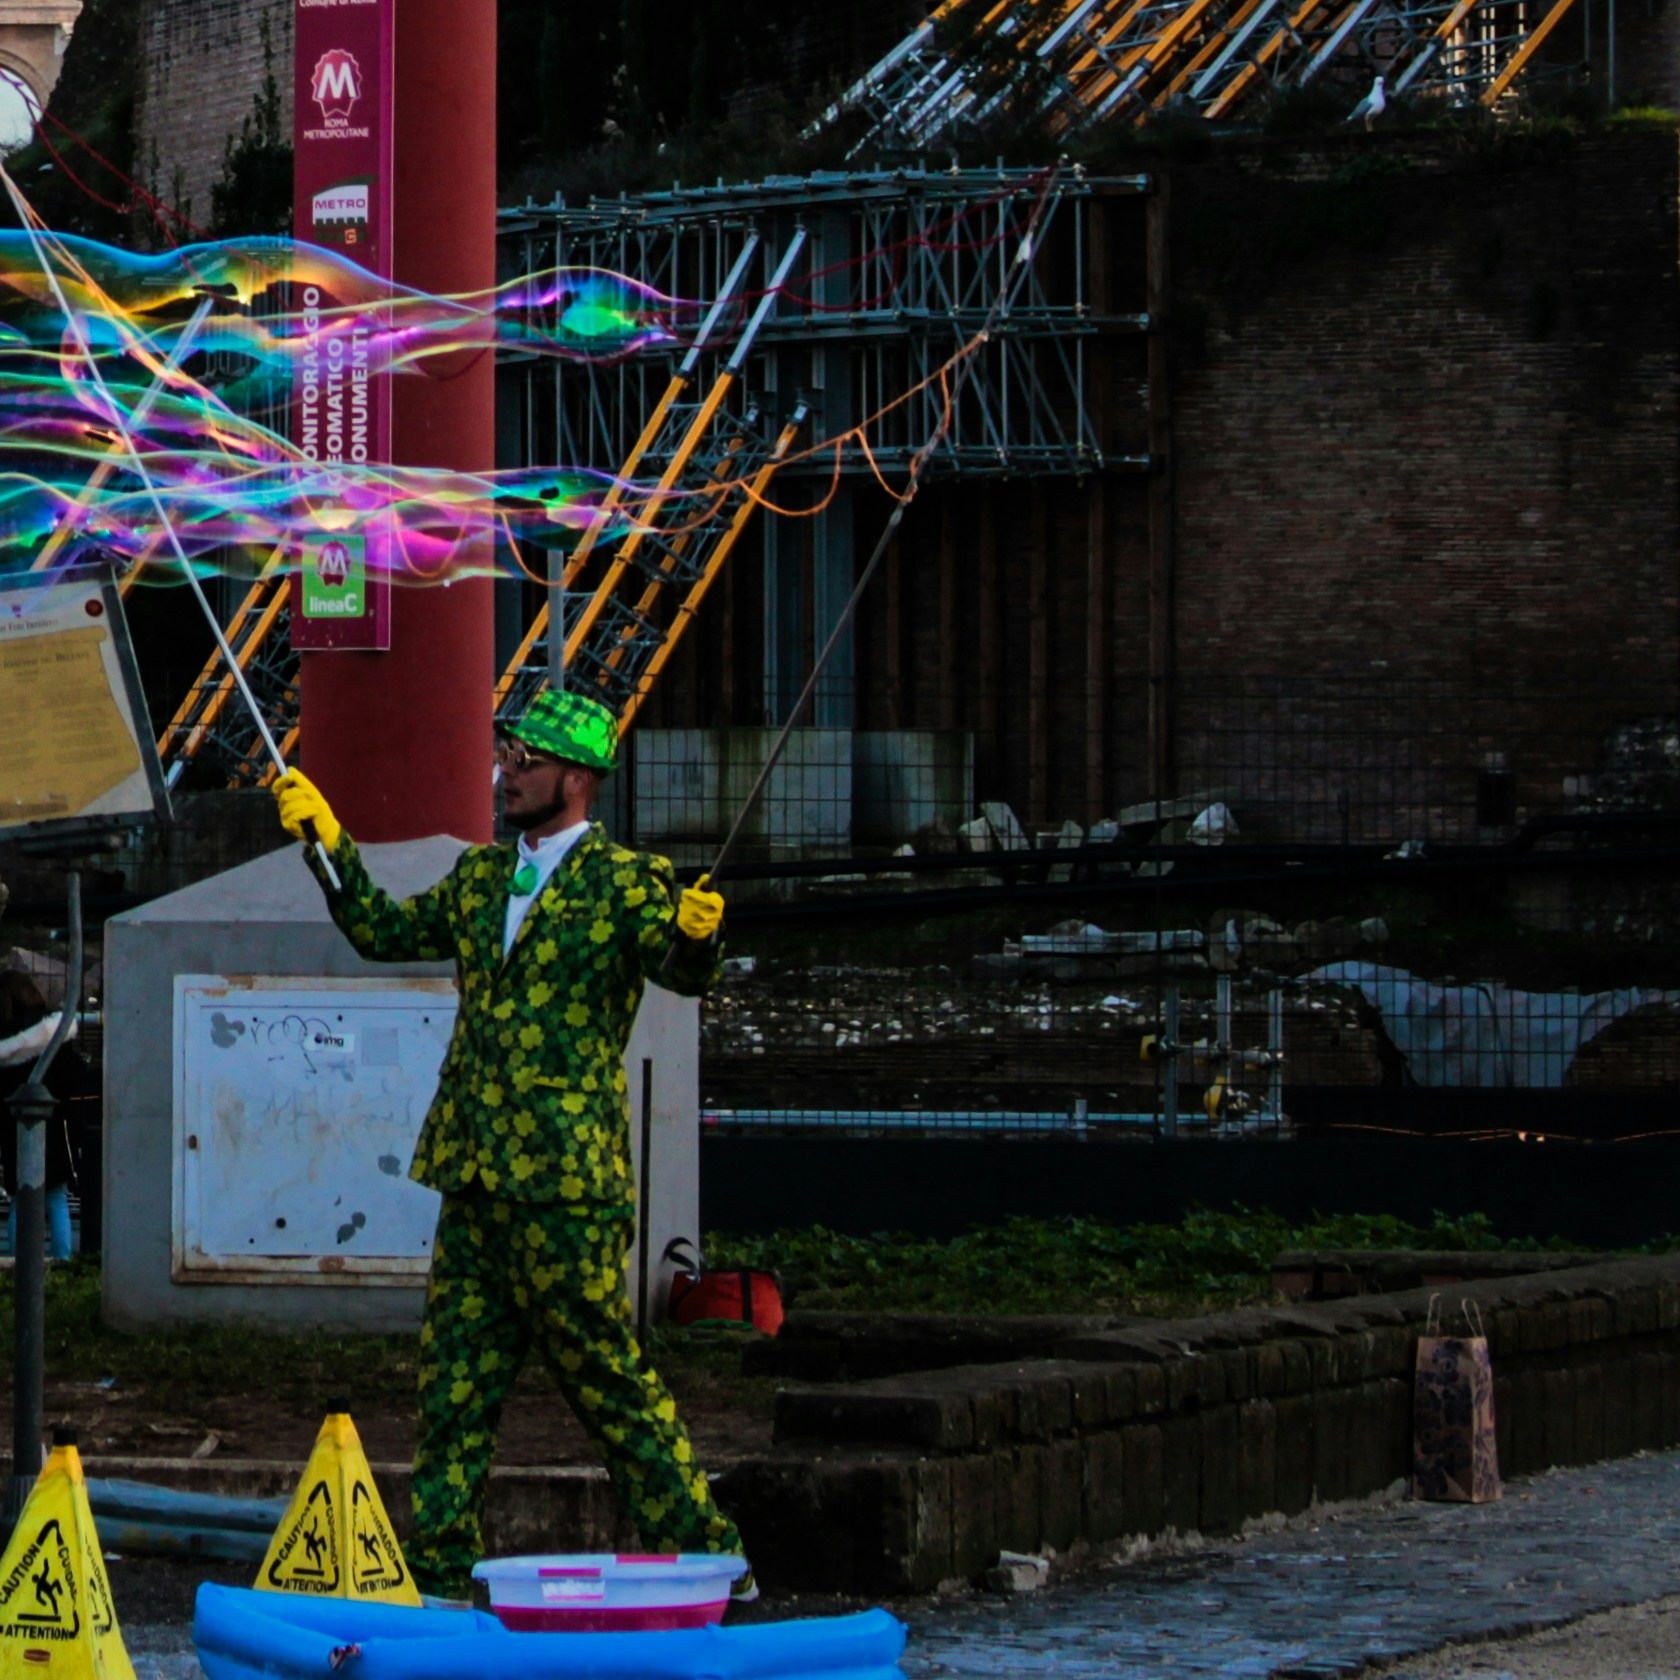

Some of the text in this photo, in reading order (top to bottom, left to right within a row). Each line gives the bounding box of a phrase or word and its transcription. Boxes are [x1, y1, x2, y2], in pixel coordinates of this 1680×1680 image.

[317, 62, 356, 99] M
[324, 118, 349, 128] ROMA
[303, 127, 369, 139] METROPOLITANE
[315, 198, 366, 209] METRO
[320, 549, 348, 575] M
[5, 1624, 70, 1641] ATTENTION
